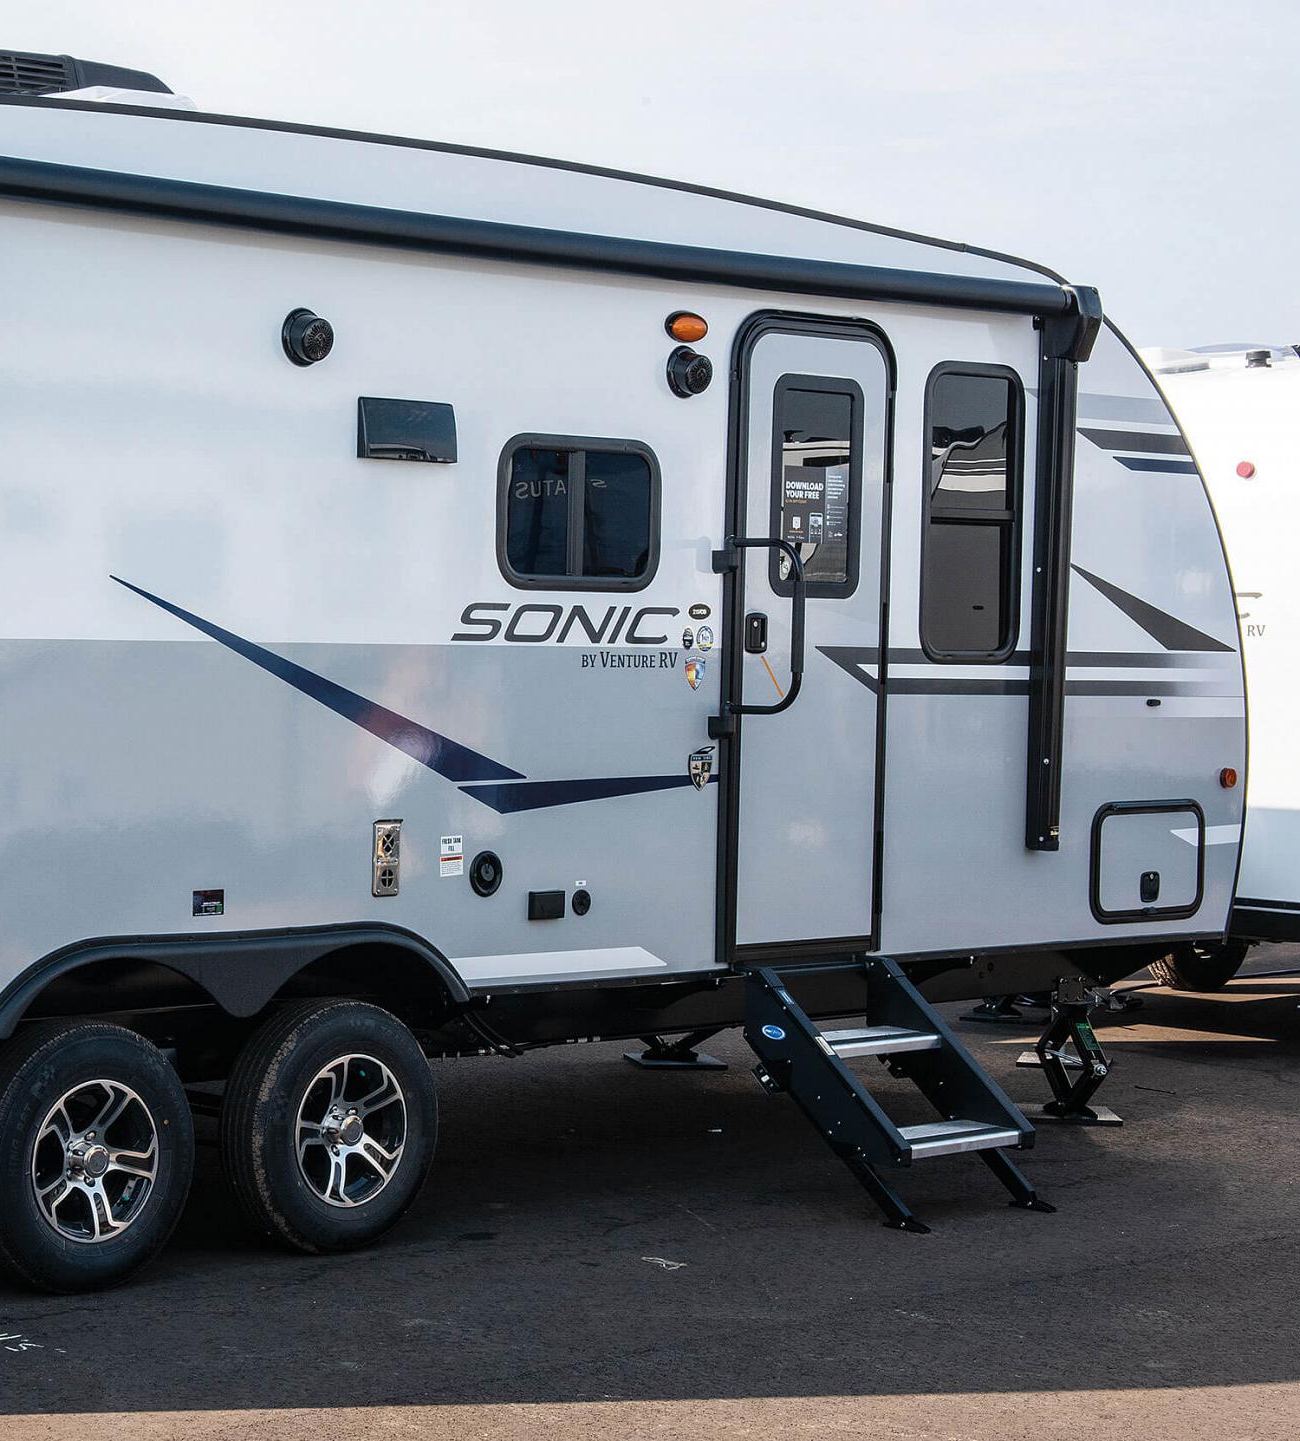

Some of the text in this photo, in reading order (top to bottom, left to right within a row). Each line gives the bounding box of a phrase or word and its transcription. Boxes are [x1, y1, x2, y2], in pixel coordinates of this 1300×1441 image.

[785, 481, 824, 491] DOWNLOAD
[785, 489, 820, 500] YOUR FREE
[450, 602, 680, 645] SONIC
[1247, 624, 1266, 637] RV
[581, 654, 597, 668] BY
[600, 652, 656, 668] VENTURE
[658, 652, 679, 668] RV
